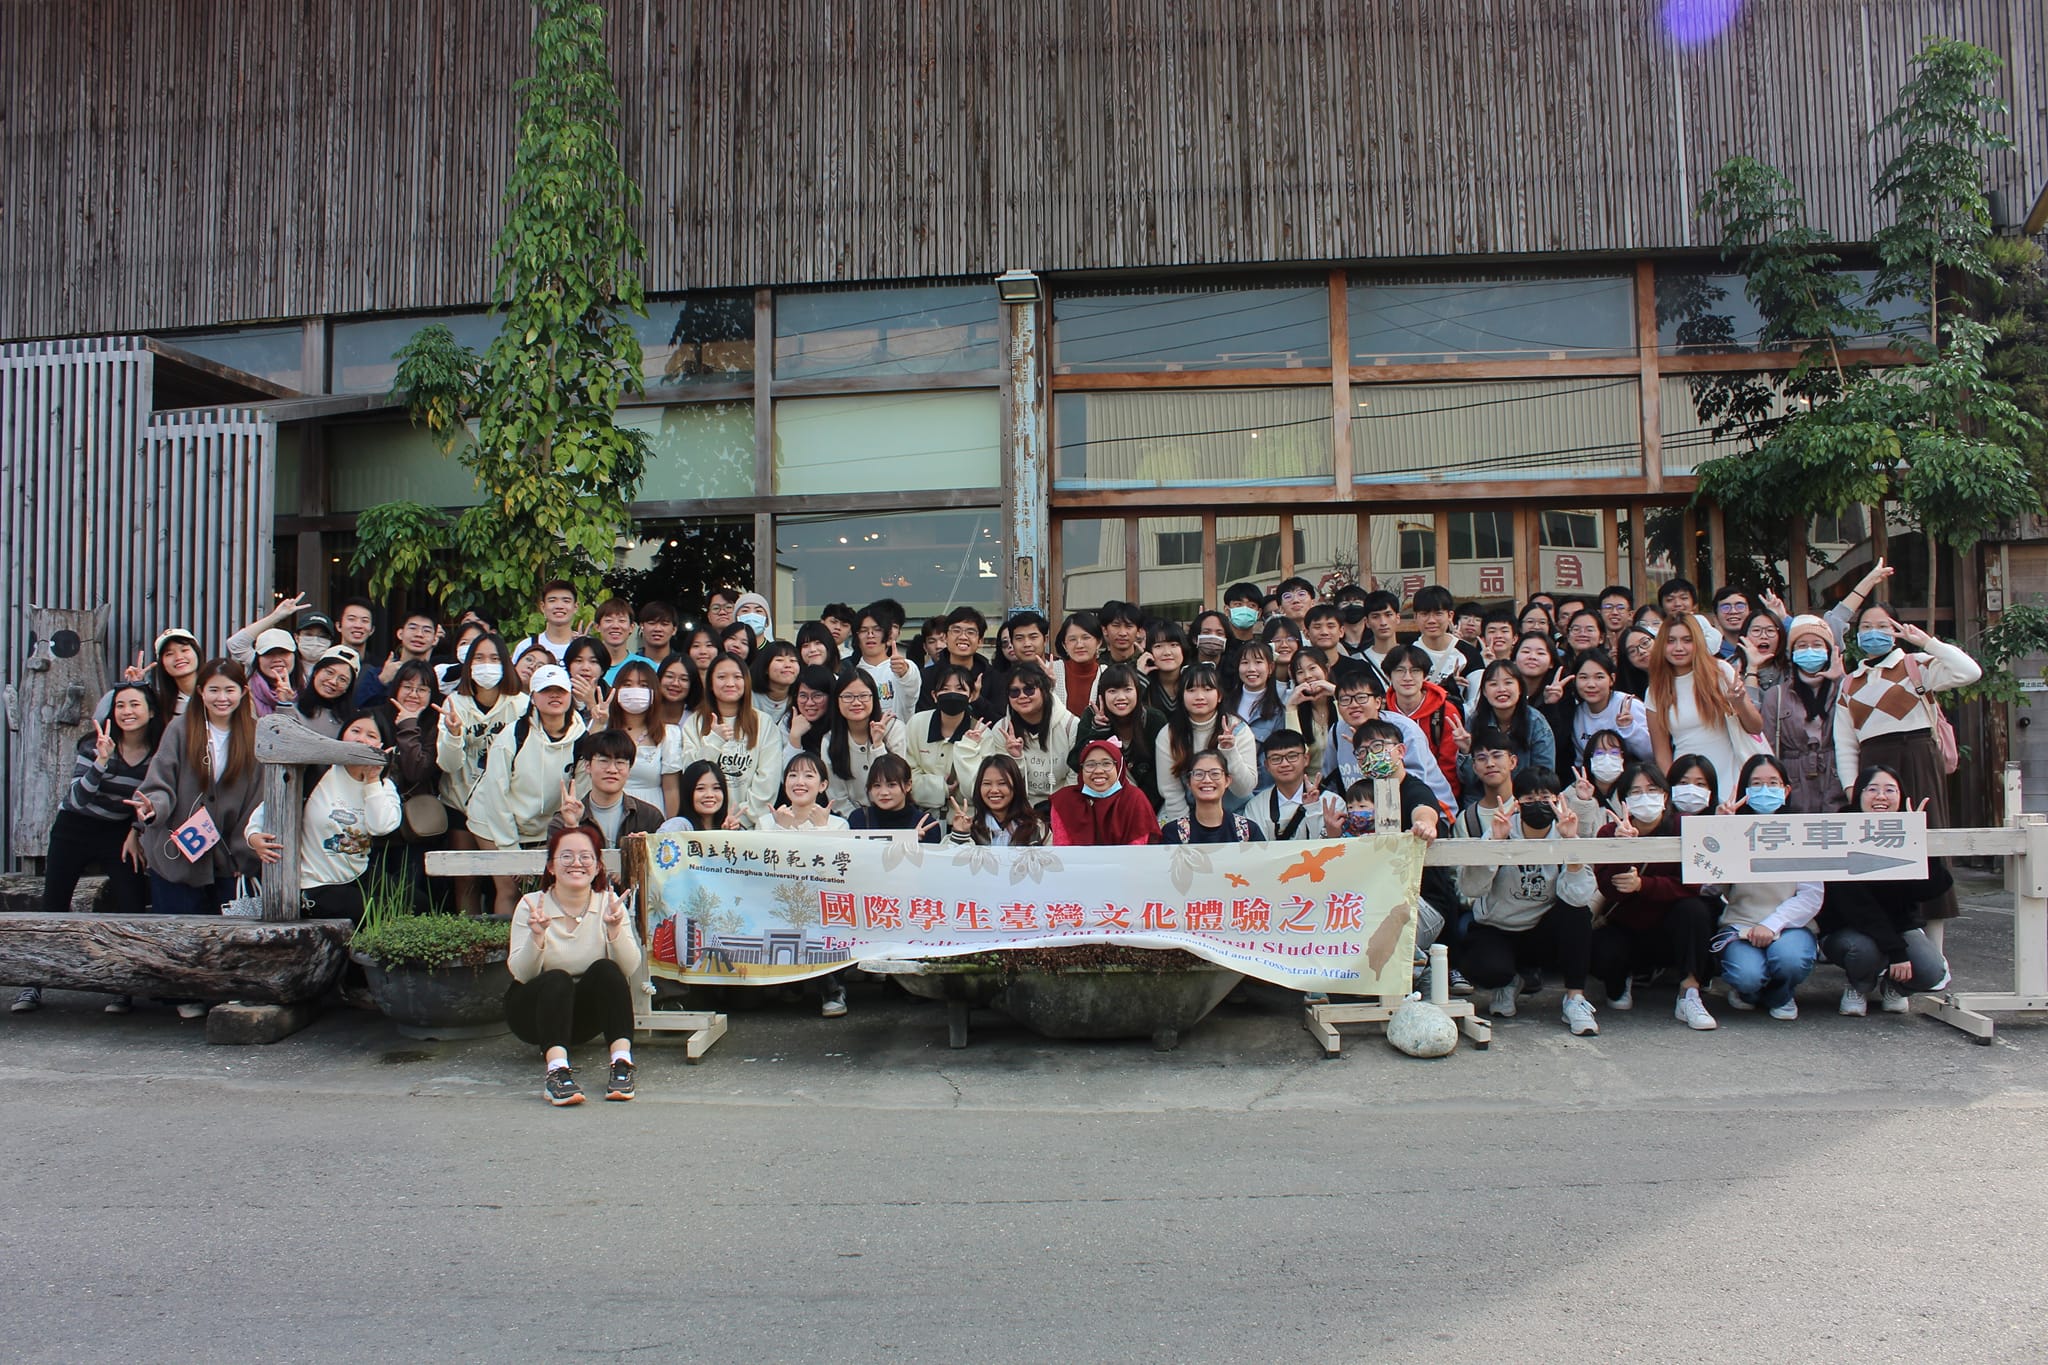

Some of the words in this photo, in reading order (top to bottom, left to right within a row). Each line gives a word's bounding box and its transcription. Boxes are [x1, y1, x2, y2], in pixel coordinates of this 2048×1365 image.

[177, 826, 206, 855] B
[1744, 818, 1906, 851] 停車場
[687, 840, 851, 876] 國立彰化師範大學
[689, 863, 723, 873] National
[725, 867, 763, 877] Changhua
[764, 871, 800, 881] University
[810, 875, 845, 884] Education
[819, 890, 1364, 933] 國際學生臺灣文化體驗之旅
[1262, 941, 1360, 956] Students
[1321, 968, 1360, 979] Affairs
